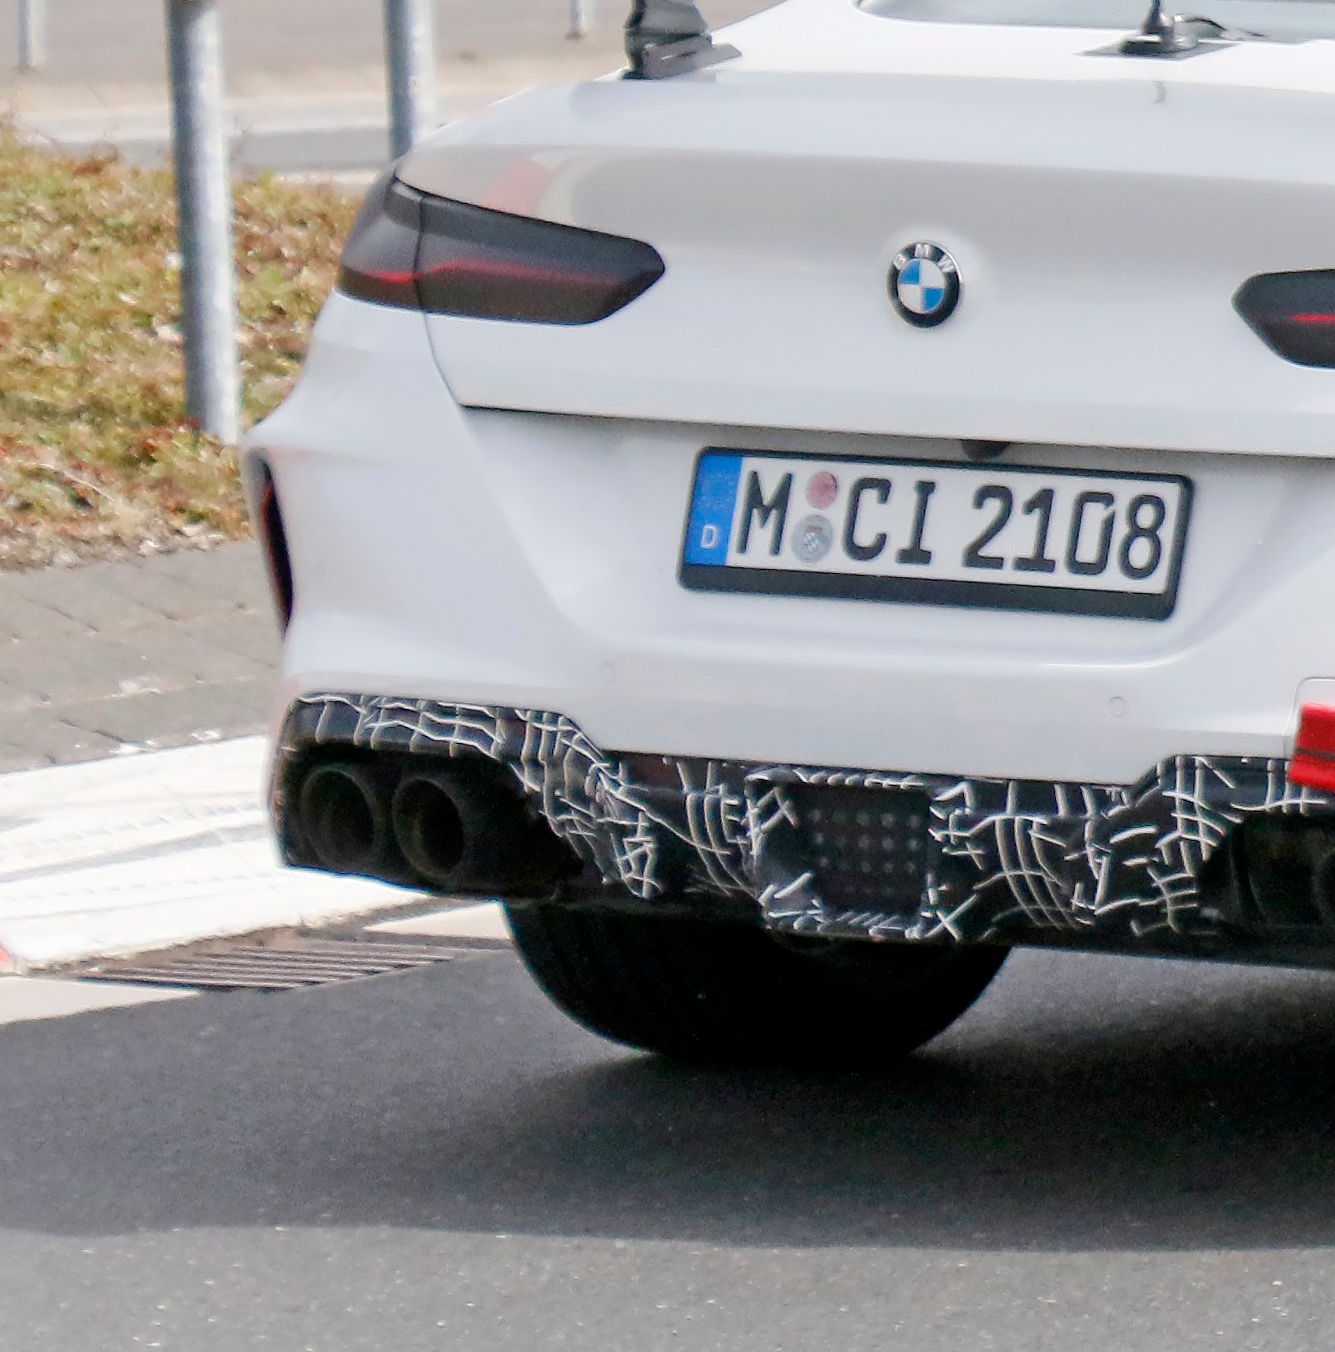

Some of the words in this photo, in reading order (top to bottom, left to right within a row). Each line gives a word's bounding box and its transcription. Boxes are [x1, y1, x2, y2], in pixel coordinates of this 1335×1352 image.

[702, 524, 718, 549] D
[735, 470, 793, 556] M
[842, 476, 937, 565] CI
[962, 484, 1167, 580] 2108
